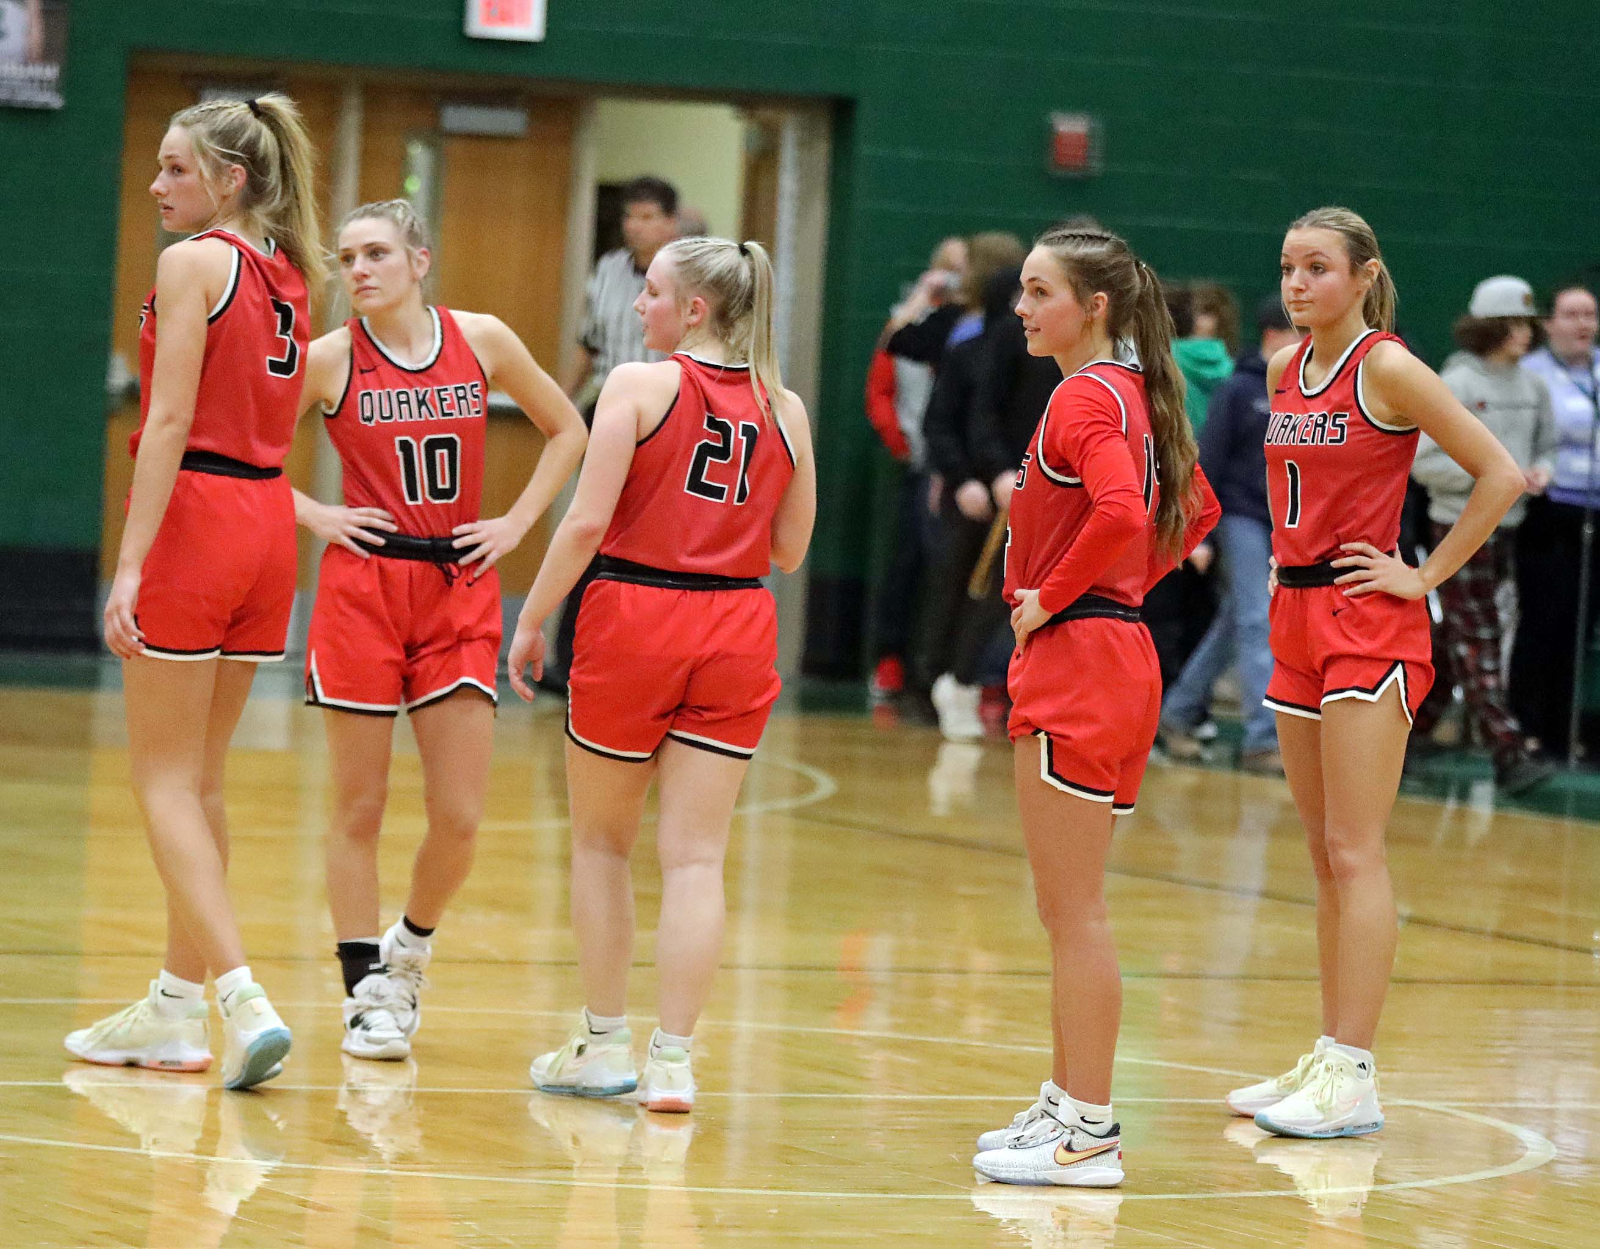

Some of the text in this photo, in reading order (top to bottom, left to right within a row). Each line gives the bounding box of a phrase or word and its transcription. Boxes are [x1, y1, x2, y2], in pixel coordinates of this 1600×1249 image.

[265, 297, 300, 379] 3
[359, 381, 482, 426] QUAKERS
[1265, 410, 1350, 445] UAKERS
[394, 433, 461, 505] 10
[684, 412, 760, 505] 21
[1284, 459, 1301, 528] 1
